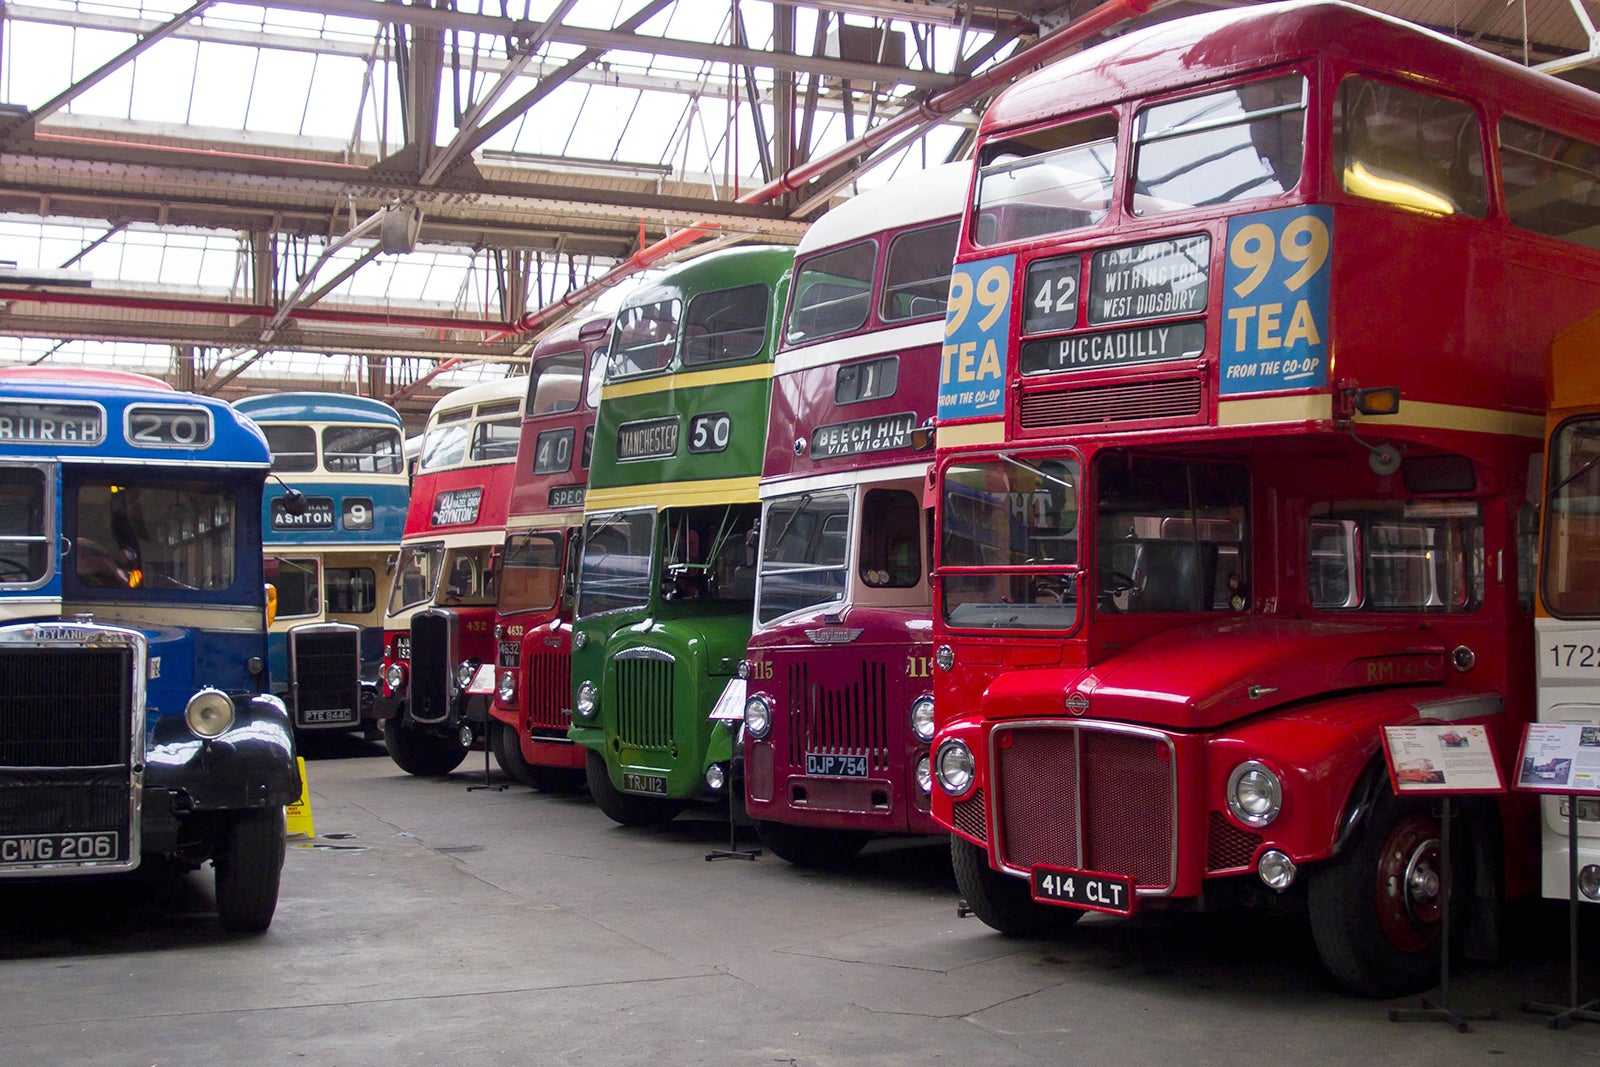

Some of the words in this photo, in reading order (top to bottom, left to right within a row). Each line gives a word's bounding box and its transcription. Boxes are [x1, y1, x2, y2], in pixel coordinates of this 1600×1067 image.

[1229, 215, 1329, 299] 99
[1105, 262, 1198, 293] WITHINGTON
[945, 265, 1010, 337] 99
[1034, 276, 1076, 313] 42
[1103, 296, 1132, 319] WEST
[1137, 288, 1197, 315] DIDSBURY
[1228, 300, 1321, 352] TEA
[1059, 328, 1169, 364] PICCADILLY
[942, 338, 1002, 384] TEA
[1226, 364, 1256, 378] FROM
[1260, 362, 1279, 376] THE
[863, 366, 874, 397] 1
[939, 393, 957, 407] FROM
[959, 392, 973, 405] THE
[134, 414, 198, 443] 20
[621, 423, 677, 458] MANCHESTER
[693, 415, 729, 448] 50
[820, 426, 871, 447] BEECH
[877, 418, 913, 439] HILL
[537, 436, 568, 468] 40
[827, 443, 849, 455] VIA
[855, 436, 903, 451] WIGAN
[553, 489, 585, 505] SPEC
[275, 512, 332, 524] ASHTON
[350, 504, 366, 524] 9
[35, 629, 86, 641] LEYLAND
[466, 621, 487, 631] 432
[506, 625, 523, 636] 4632
[1550, 644, 1600, 667] 172
[754, 661, 774, 680] 115
[305, 712, 325, 721] PTE
[807, 756, 835, 774] DJP
[837, 757, 866, 775] 754
[628, 776, 647, 791] TRJ
[649, 778, 663, 792] 112
[1, 838, 53, 861] CWG
[61, 836, 111, 858] 206
[1042, 874, 1075, 898] 414
[1086, 880, 1123, 905] CLT
